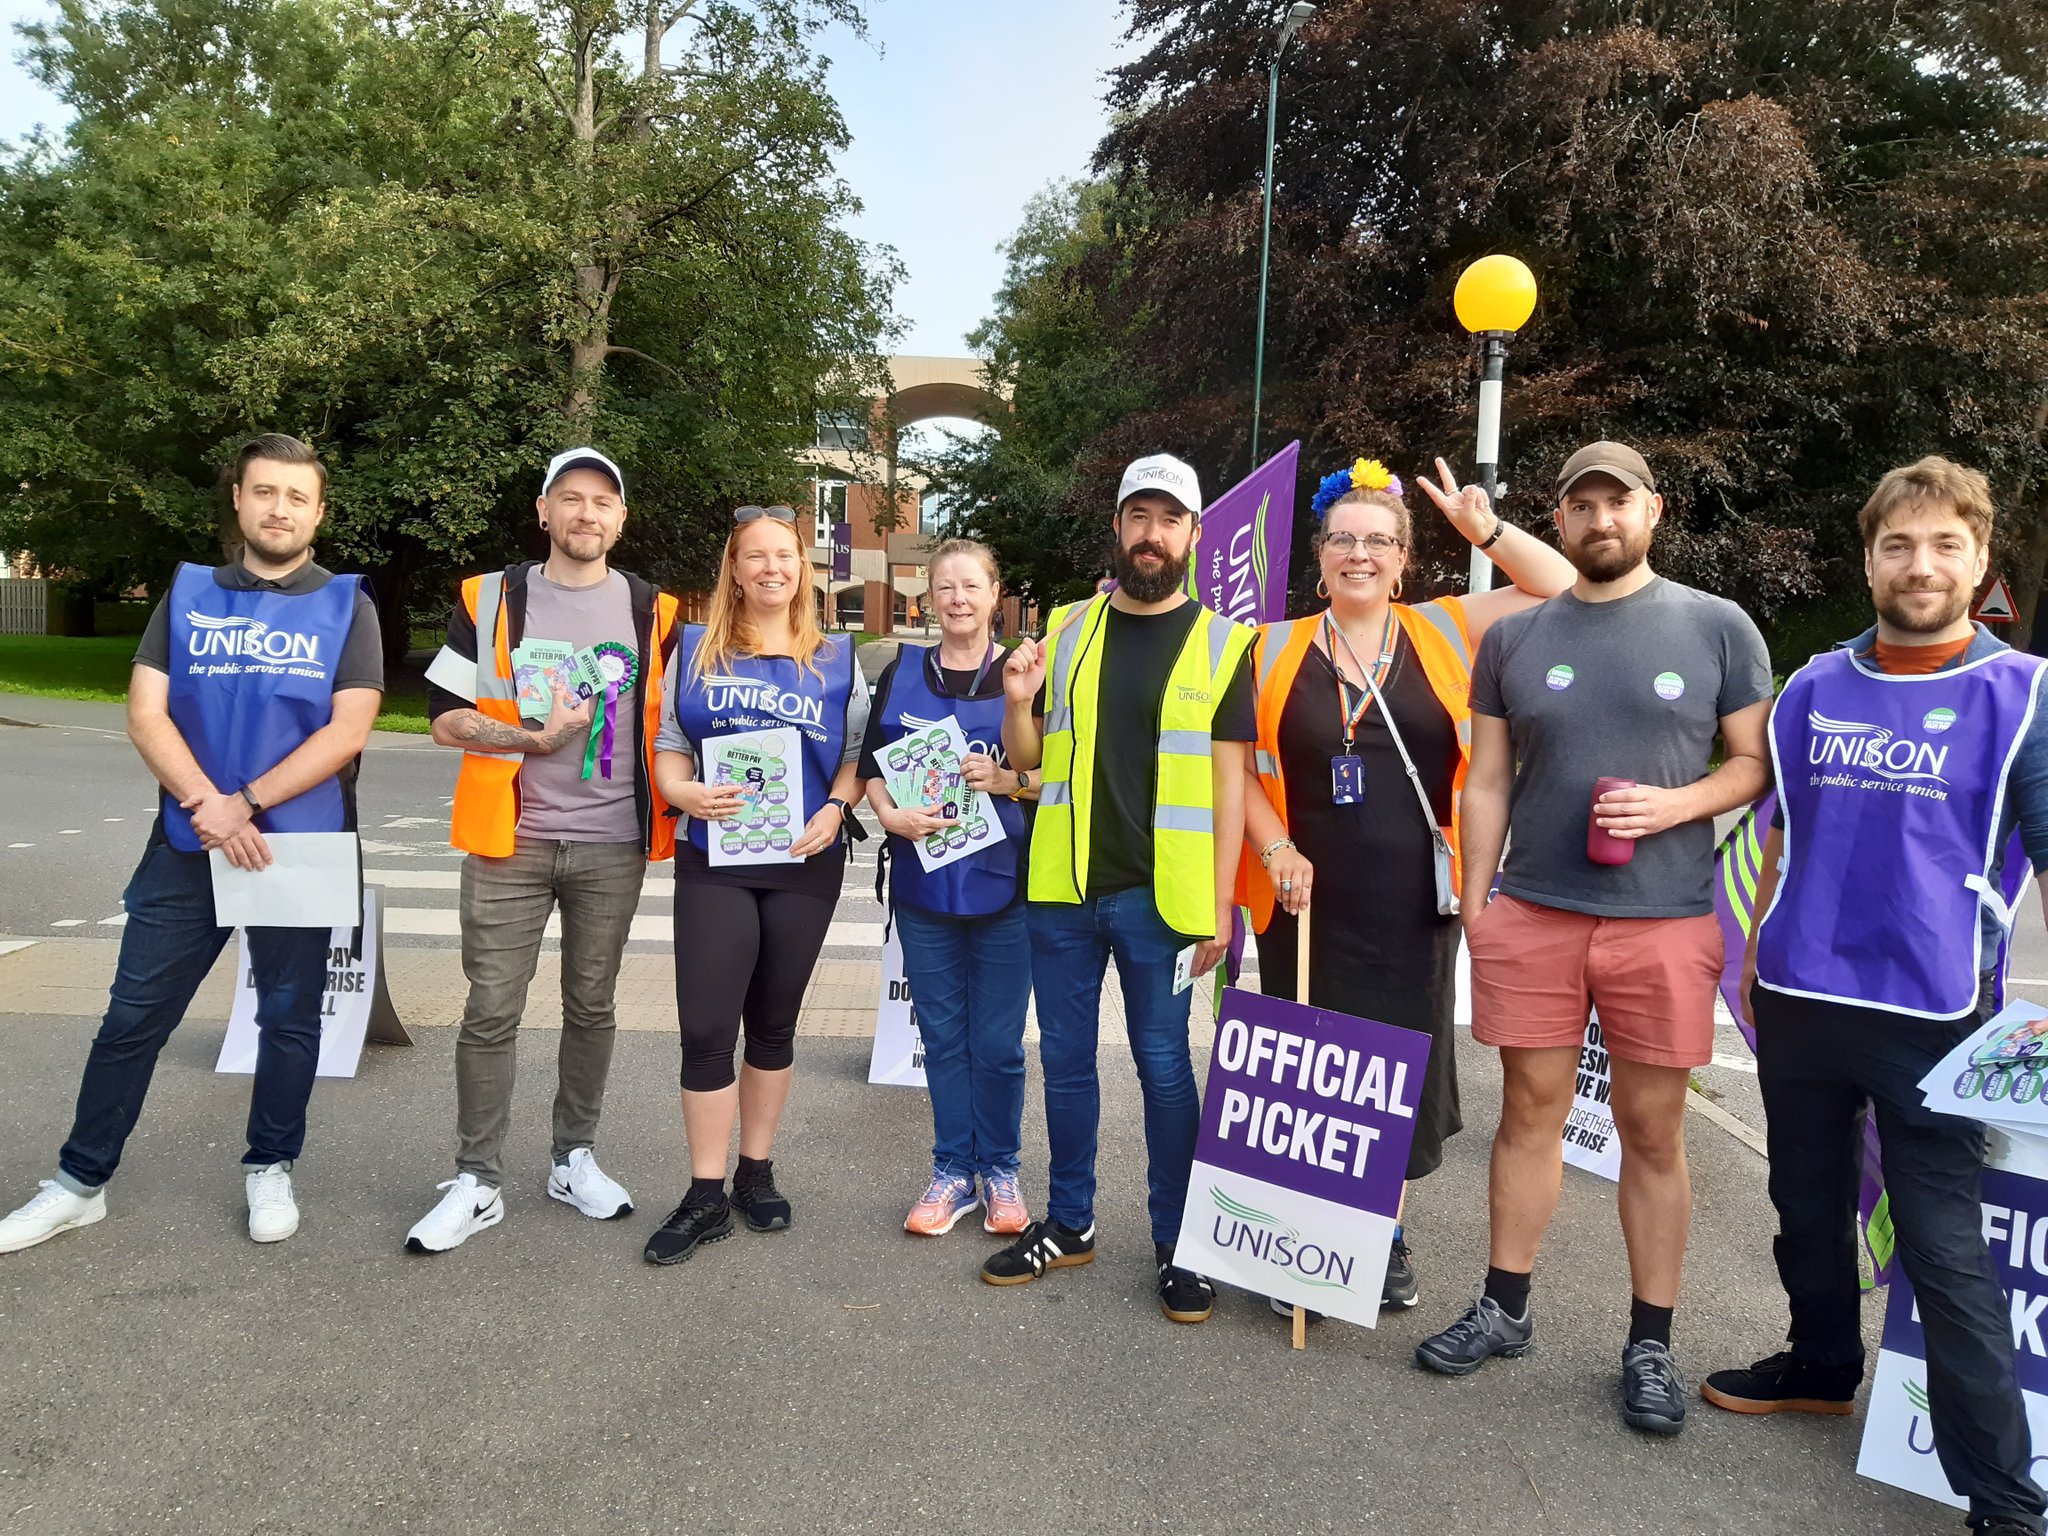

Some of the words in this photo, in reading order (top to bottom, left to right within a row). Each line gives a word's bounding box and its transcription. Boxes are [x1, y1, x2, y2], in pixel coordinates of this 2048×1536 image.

[1137, 470, 1183, 485] UNISON
[1212, 548, 1223, 580] the
[188, 630, 318, 659] UNISON
[189, 662, 205, 675] the
[207, 663, 242, 677] public
[244, 664, 286, 674] service
[288, 666, 326, 679] union
[707, 686, 823, 723] UNISON
[712, 717, 727, 729] the
[728, 715, 759, 728] public
[801, 727, 828, 743] nion
[727, 750, 749, 761] BETTER
[1809, 736, 1949, 776] UNISON
[1820, 773, 1858, 788] public
[1860, 779, 1903, 792] service
[1905, 785, 1948, 801] union
[325, 971, 365, 992] RISE
[1217, 1019, 1413, 1118] OFFICIAL
[1218, 1088, 1380, 1178] PICKET
[1571, 1107, 1616, 1137] OGETHER
[1577, 1130, 1609, 1154] RISE
[1212, 1215, 1354, 1285] UNISON
